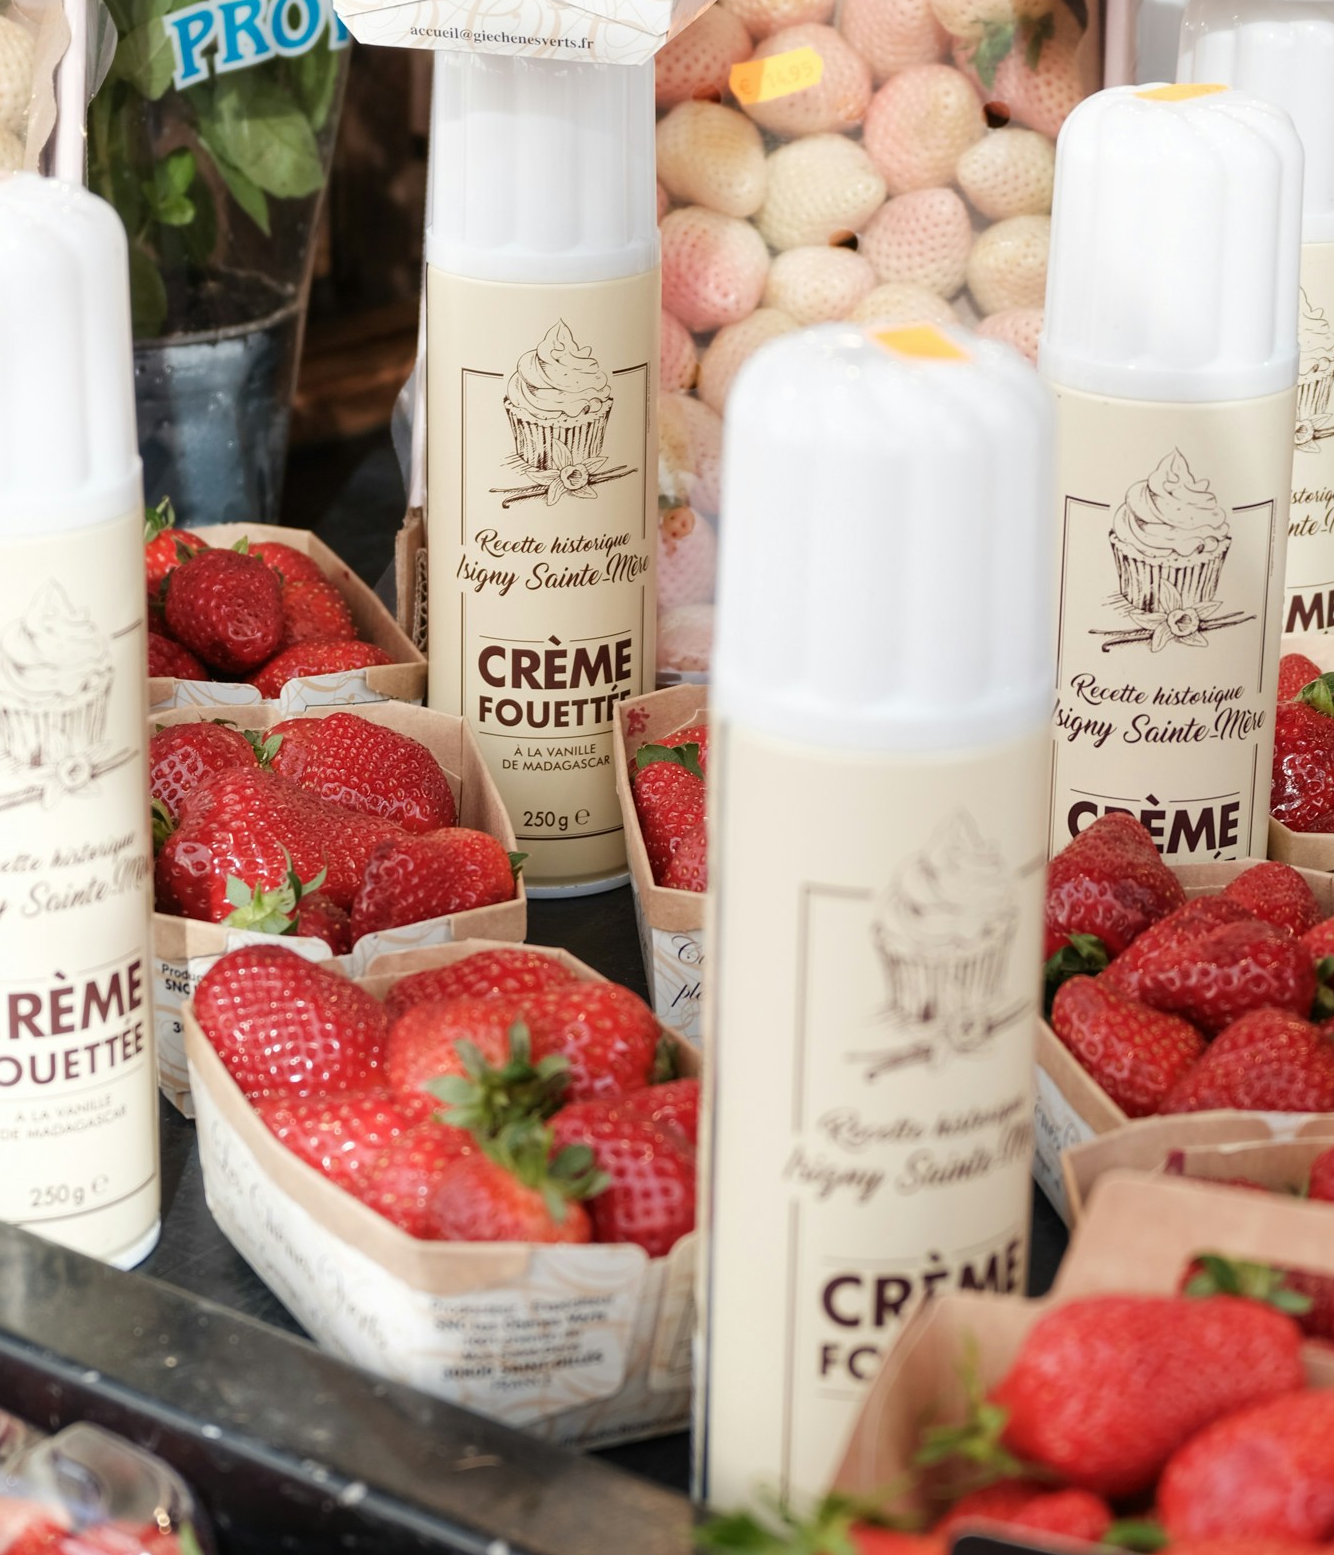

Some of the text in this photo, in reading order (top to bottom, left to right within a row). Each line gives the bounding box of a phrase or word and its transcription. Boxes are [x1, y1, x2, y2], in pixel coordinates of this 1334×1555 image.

[410, 24, 594, 51] accueil@giechenesverts.fr
[474, 528, 632, 565] Recette historique
[456, 552, 650, 597] Isigny Sainte-Mère
[478, 635, 632, 692] CRÈME
[1069, 673, 1245, 709] Recette historique
[1122, 707, 1267, 745] Sainte-Mère
[501, 754, 611, 772] DE MADAGASCAR
[526, 742, 597, 758] LA VANILLE
[51, 831, 136, 869] historique
[165, 978, 190, 995] SNC
[26, 1103, 127, 1140] MADAGASCAR
[55, 1092, 113, 1119] VANILLE
